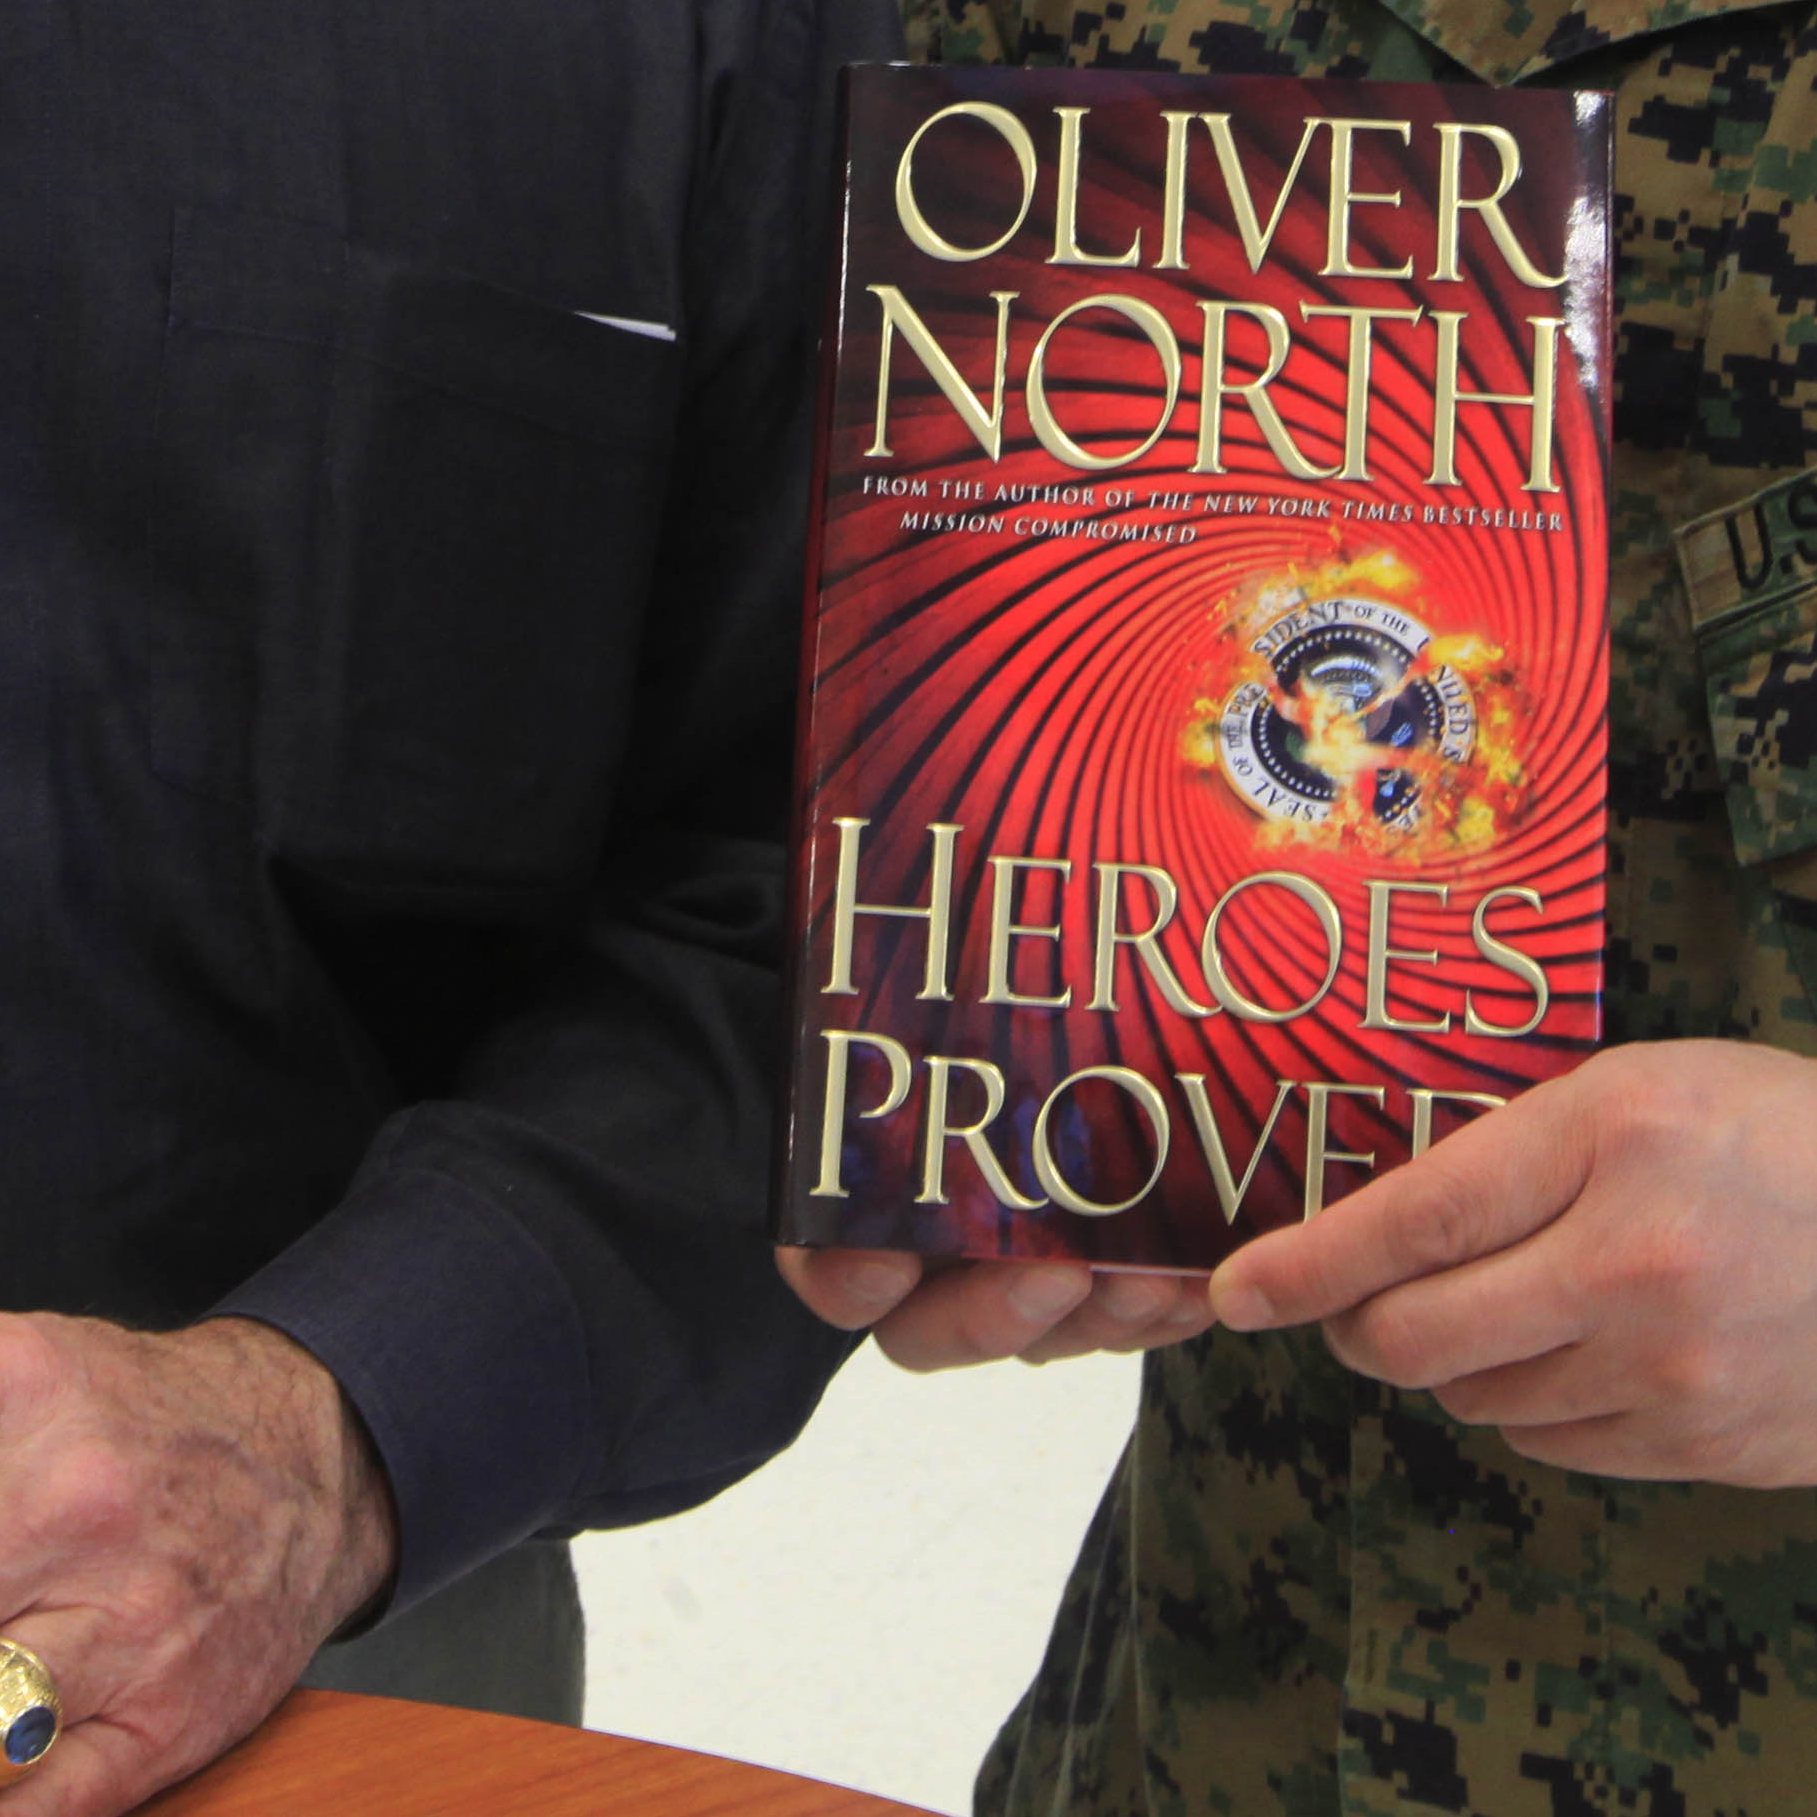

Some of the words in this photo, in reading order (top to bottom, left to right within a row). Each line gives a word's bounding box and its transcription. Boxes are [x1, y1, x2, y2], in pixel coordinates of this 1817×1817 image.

[895, 100, 1569, 289] OLIVER
[863, 284, 1561, 493] NORTH
[862, 476, 928, 497] FROM
[939, 480, 985, 501] THE
[994, 483, 1095, 506] AUTHOR
[1105, 489, 1136, 508] OF
[1147, 491, 1193, 512] THE
[1203, 494, 1259, 514] NEW
[1267, 496, 1331, 518] YORK
[1342, 500, 1414, 523] TIMES
[1423, 505, 1564, 531] BESTSELLER
[899, 511, 1006, 535] MISSION
[1014, 516, 1198, 544] COMPROMISED
[1353, 602, 1376, 620] OF
[1381, 612, 1412, 636] THE
[820, 816, 1550, 1039] HEROES
